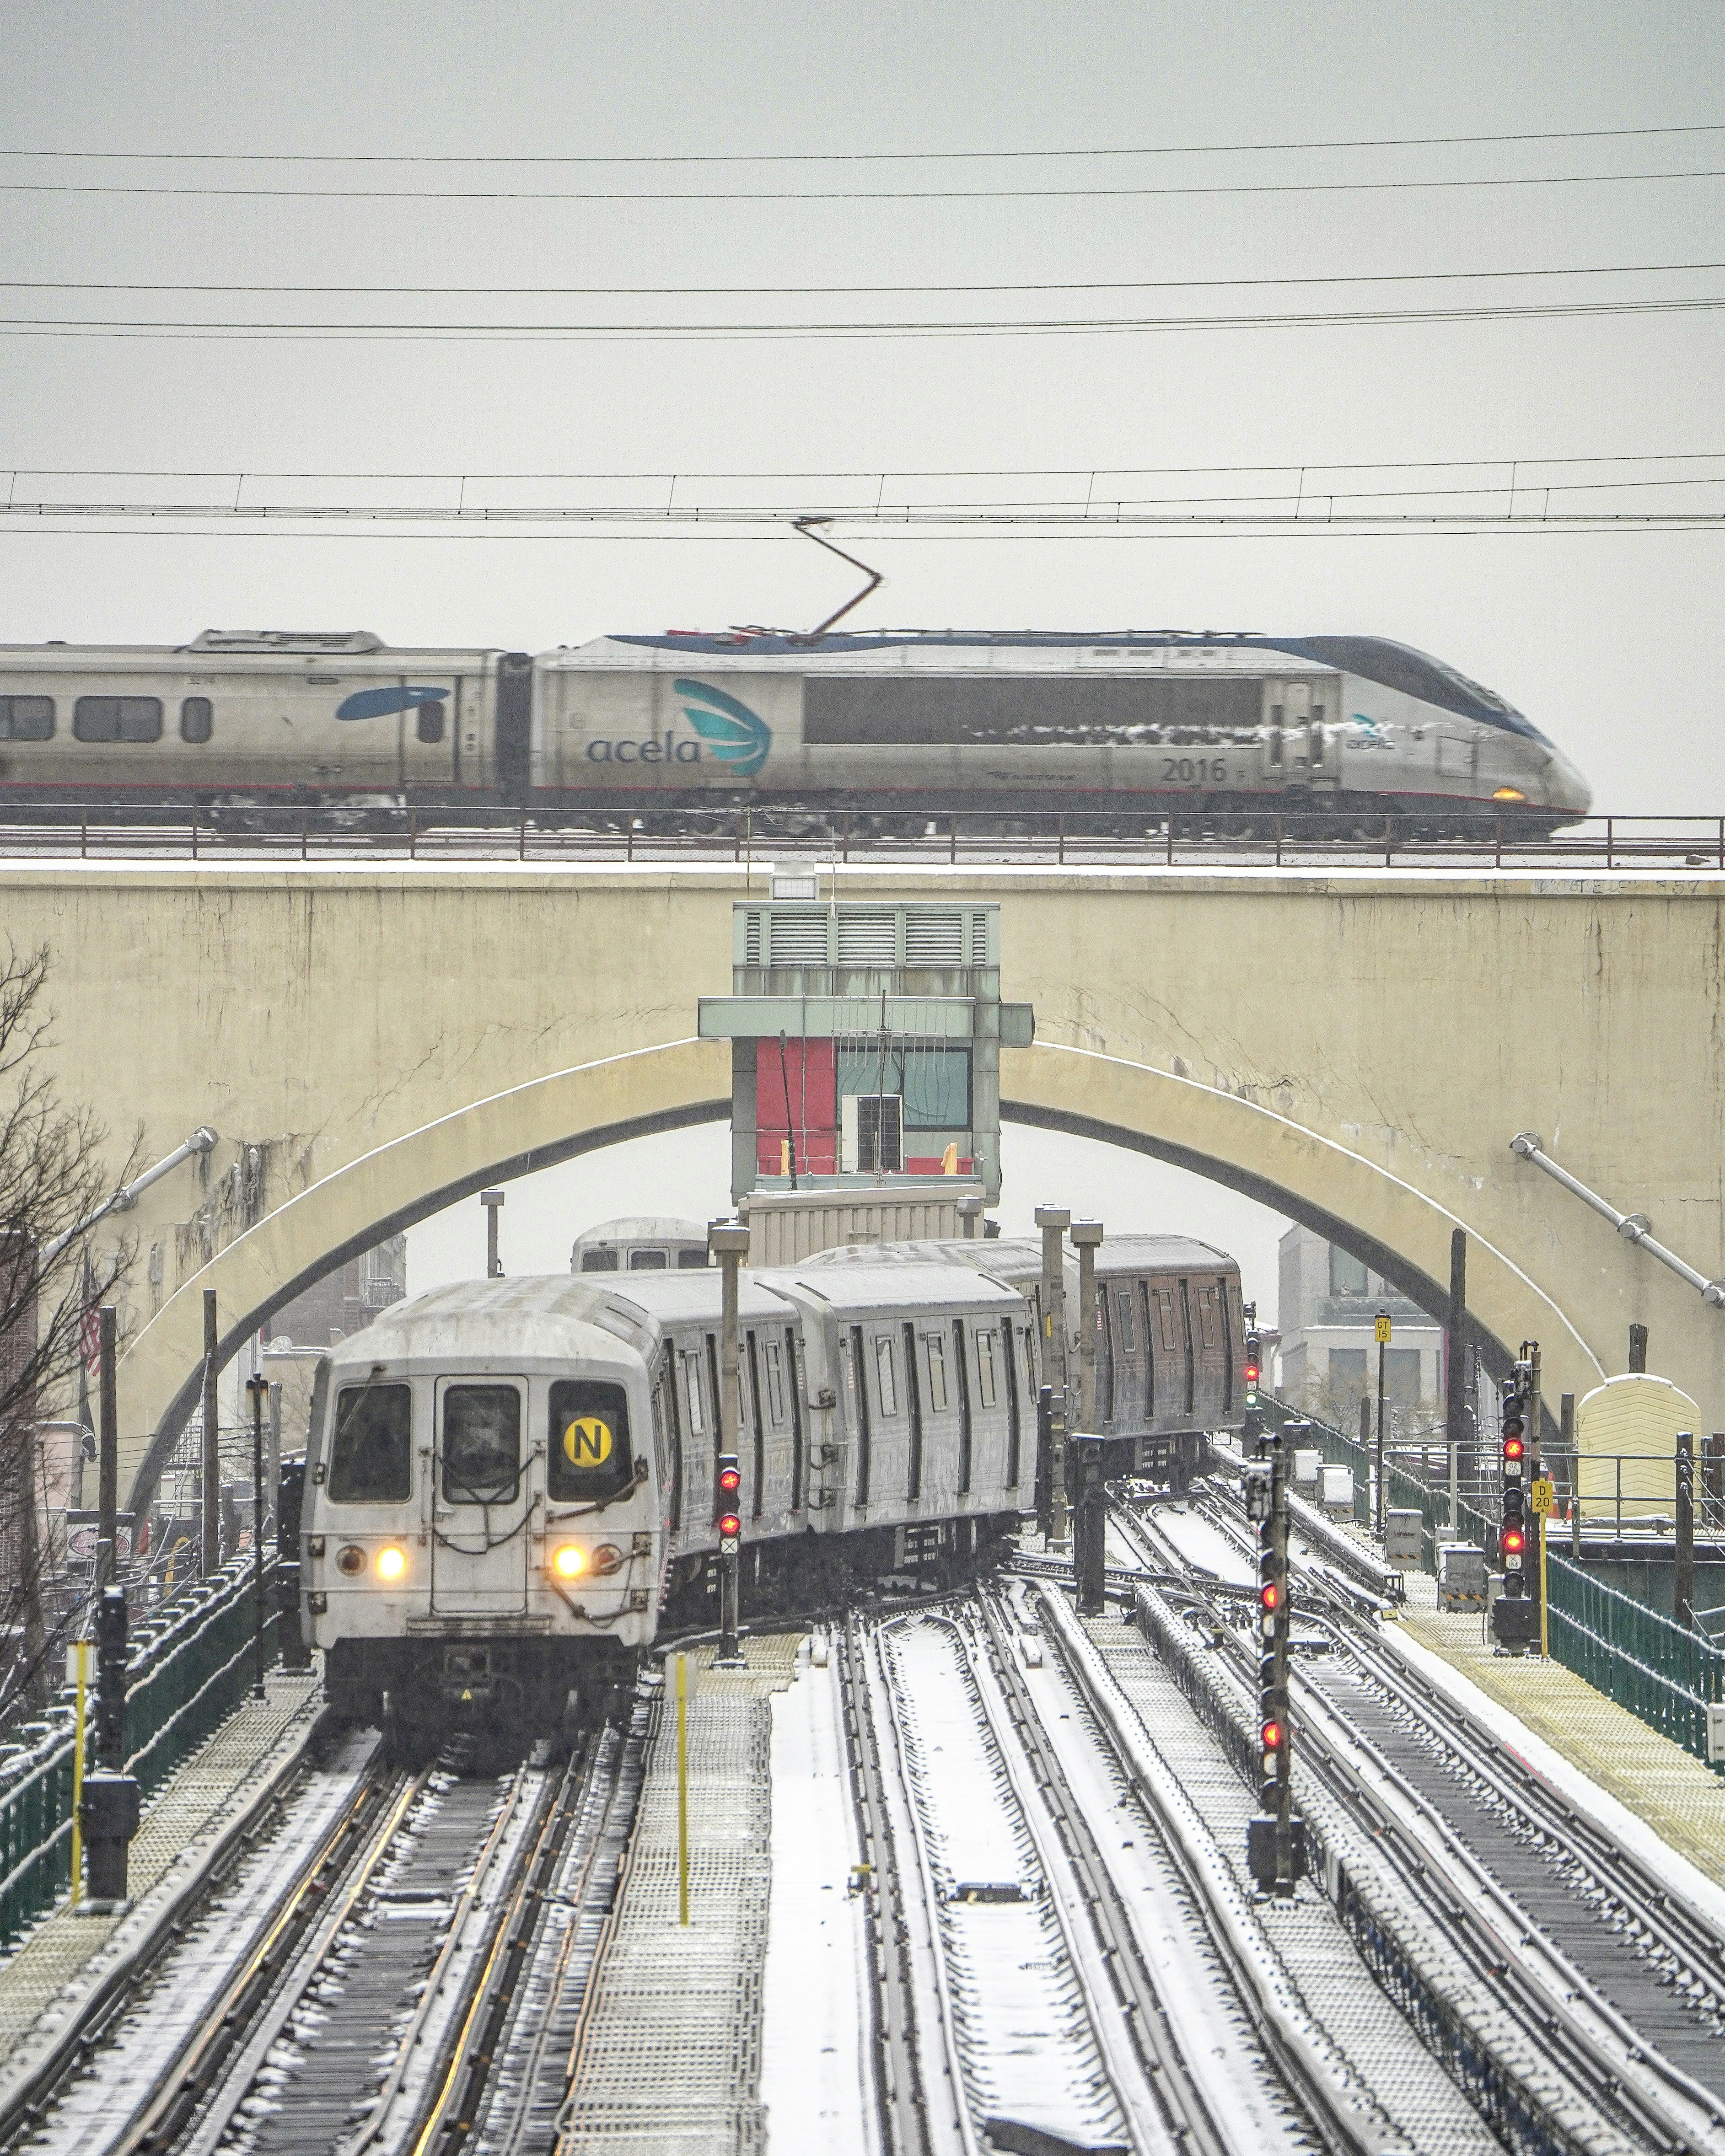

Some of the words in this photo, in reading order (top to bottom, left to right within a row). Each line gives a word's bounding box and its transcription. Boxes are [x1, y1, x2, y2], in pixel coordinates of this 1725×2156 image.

[586, 730, 701, 763] acela
[1161, 758, 1227, 782] 2016
[574, 1425, 601, 1459] N
[1536, 1497, 1550, 1507] 20
[1539, 1486, 1546, 1495] D
